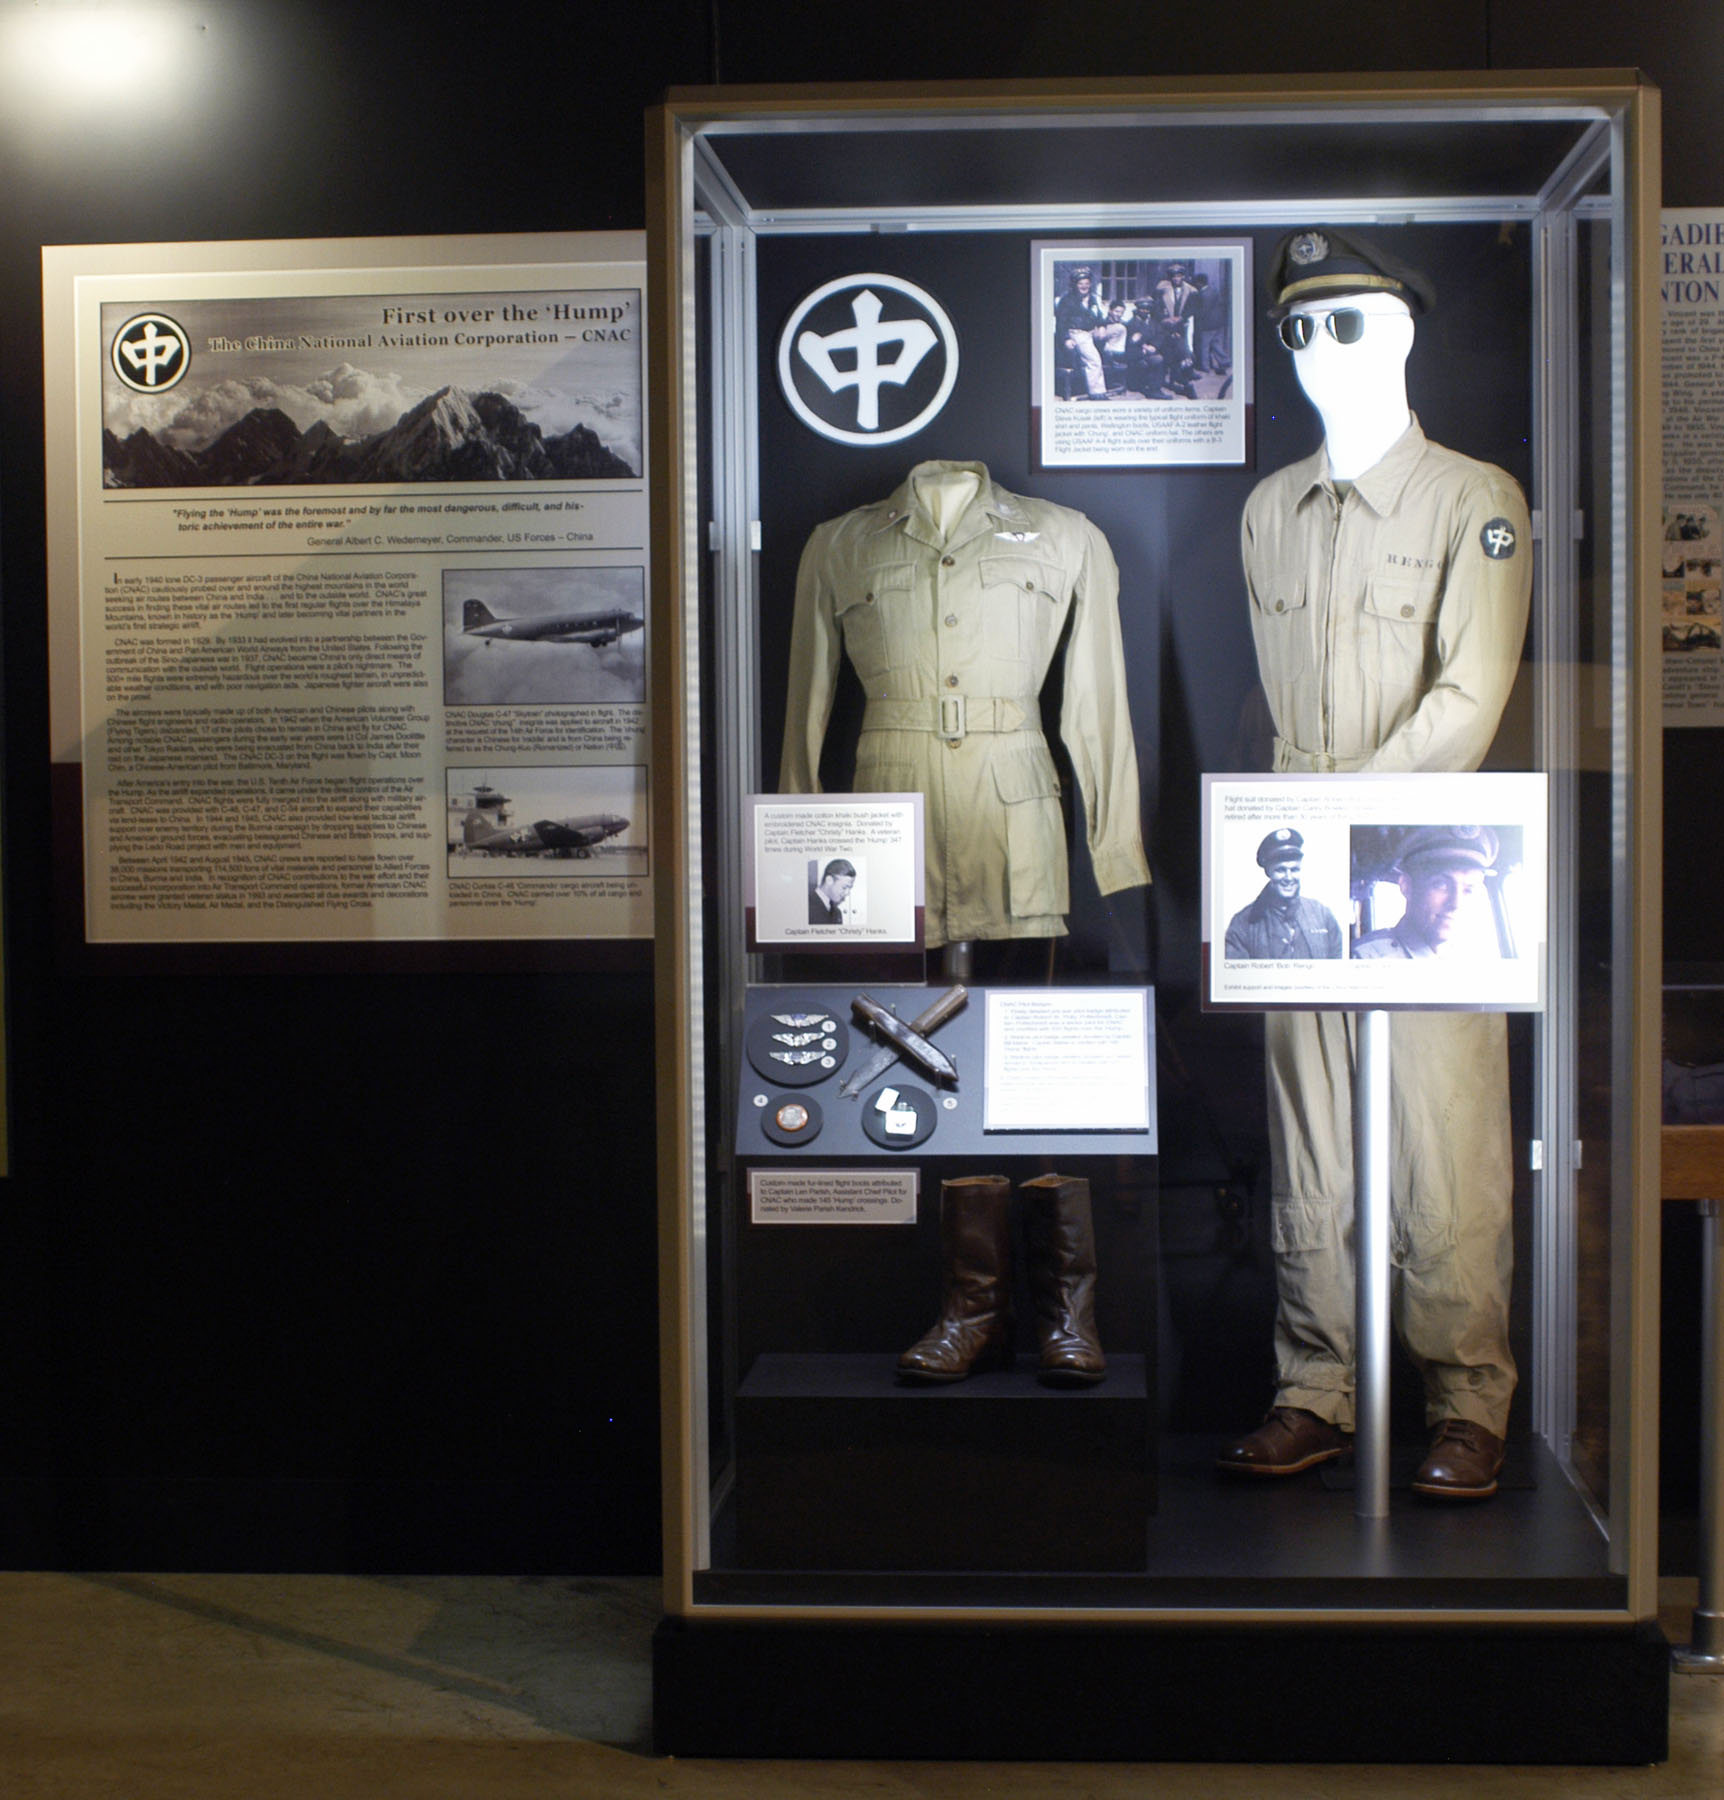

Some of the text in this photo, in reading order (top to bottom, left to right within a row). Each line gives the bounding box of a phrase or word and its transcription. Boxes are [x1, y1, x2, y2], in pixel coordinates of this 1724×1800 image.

[382, 306, 436, 324] First
[444, 309, 494, 322] over
[502, 304, 538, 321] the
[208, 336, 242, 352] The
[245, 336, 294, 350] China
[299, 334, 372, 349] National
[378, 333, 448, 347] Aviation
[454, 330, 558, 347] Corporation
[582, 328, 631, 342] CNAC
[121, 322, 180, 386] 中
[798, 288, 939, 430] 中
[209, 508, 225, 517] the
[284, 506, 300, 516] the
[302, 506, 346, 515] foremost
[348, 505, 367, 514] and
[368, 505, 381, 516] by
[383, 505, 397, 514] far
[399, 504, 415, 514] the
[417, 504, 442, 513] most
[444, 503, 499, 515] dangerous,
[543, 502, 562, 511] and
[178, 522, 200, 531] toric
[202, 521, 263, 530] achievement
[265, 520, 276, 529] of
[277, 520, 293, 529] the
[295, 519, 323, 529] entire
[307, 536, 343, 545] General
[345, 535, 372, 545] Albert
[373, 535, 384, 544] C.
[506, 533, 522, 542] US
[523, 532, 555, 542] Forces
[565, 532, 593, 541] China
[124, 576, 142, 585] early
[784, 928, 809, 936] Captain
[1224, 962, 1249, 970] Captain
